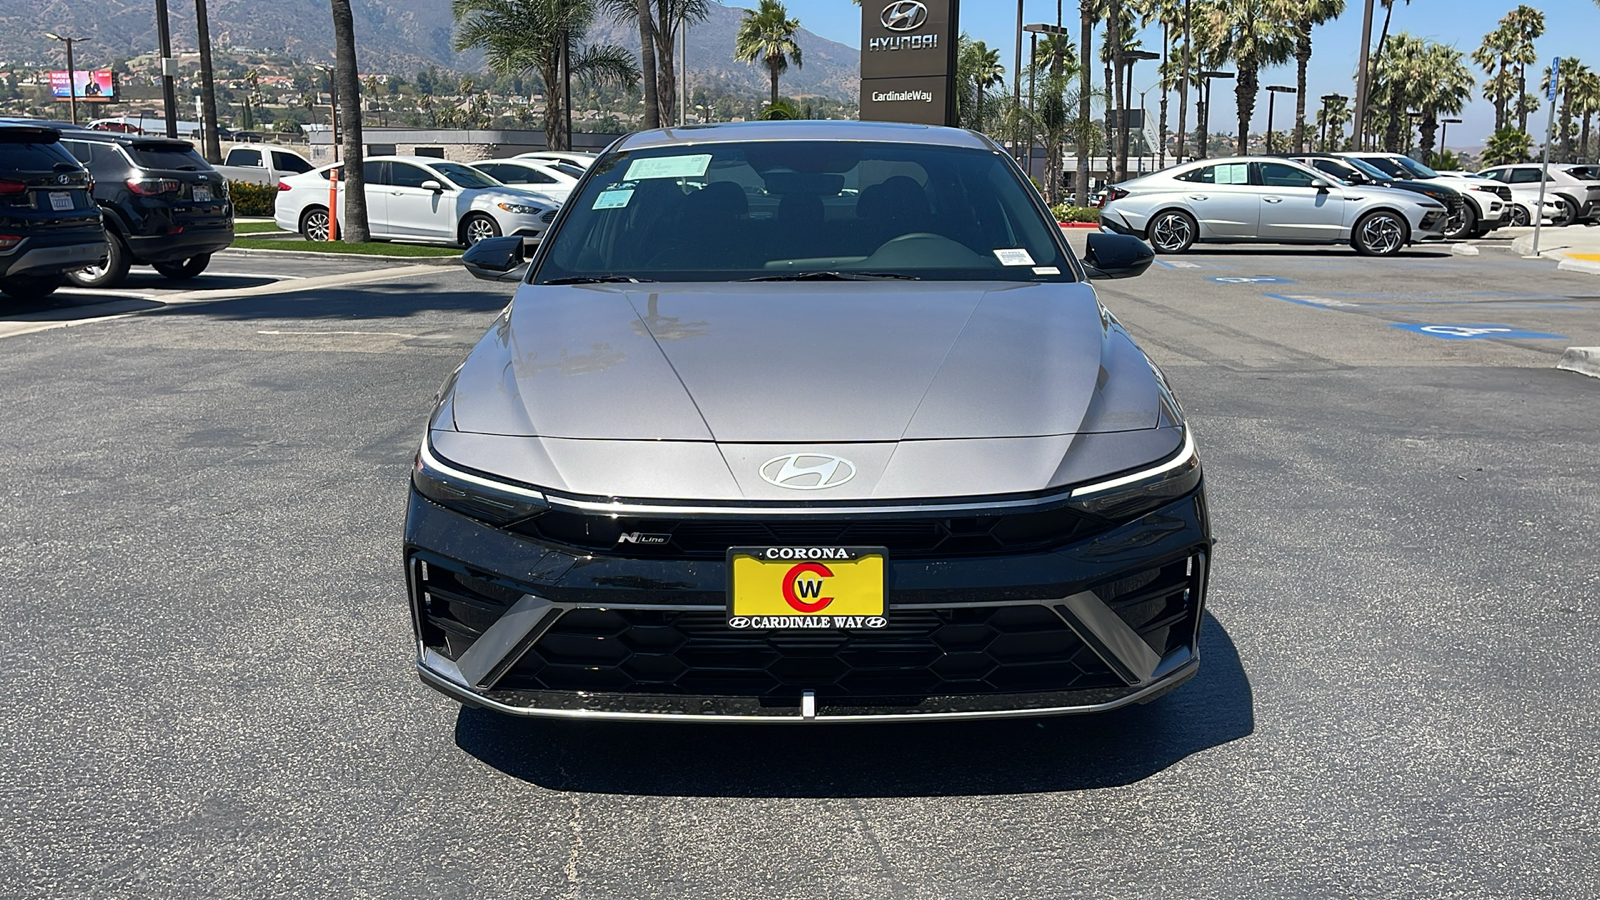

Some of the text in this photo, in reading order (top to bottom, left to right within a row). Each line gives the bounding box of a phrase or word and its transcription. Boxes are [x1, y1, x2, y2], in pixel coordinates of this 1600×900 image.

[869, 34, 938, 51] HYUNDAI
[872, 90, 932, 102] CardinaleWay
[766, 548, 849, 559] CORONA
[751, 616, 866, 629] CARDINALE WAY
